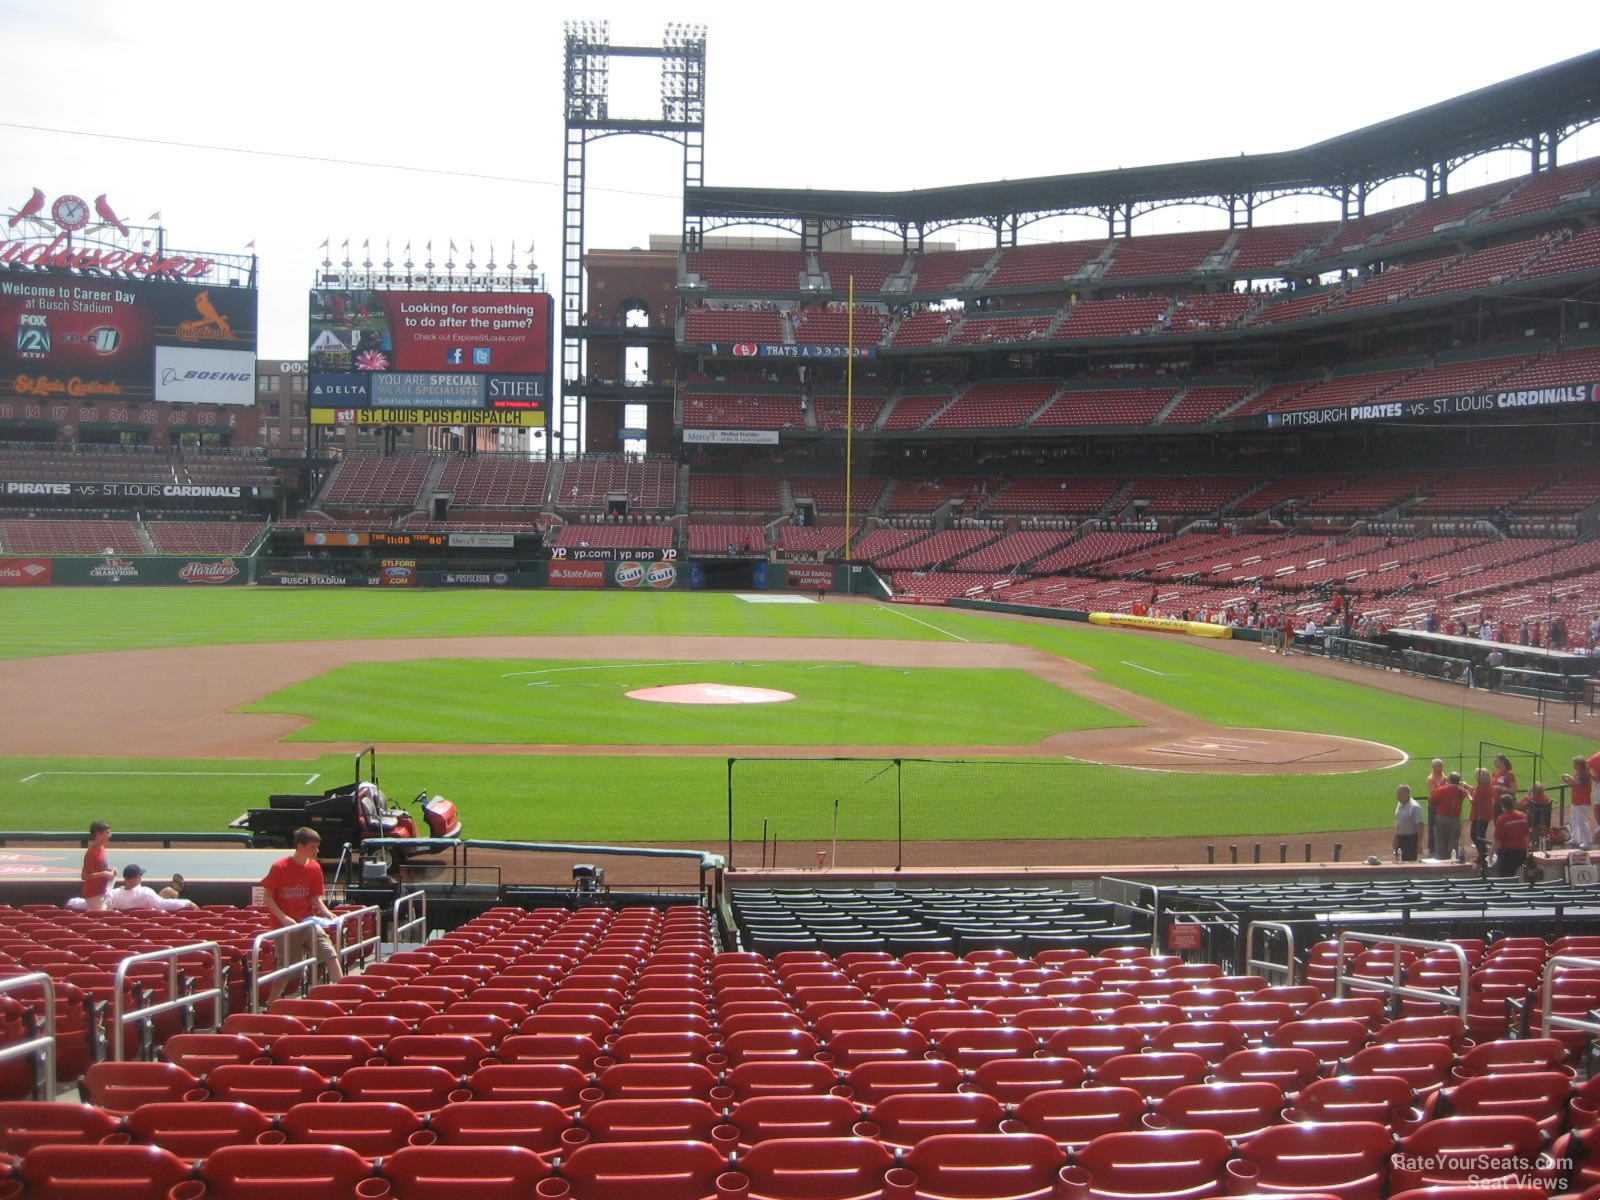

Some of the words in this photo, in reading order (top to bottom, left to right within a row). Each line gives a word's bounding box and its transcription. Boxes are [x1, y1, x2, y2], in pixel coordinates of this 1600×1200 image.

[0, 231, 215, 278] udweiser
[337, 273, 405, 285] WORLD
[411, 272, 524, 286] CHAMPIONS
[2, 282, 55, 297] Welcome
[59, 286, 70, 298] to
[74, 287, 112, 300] Career
[116, 290, 136, 304] Day
[25, 298, 36, 308] at
[39, 298, 70, 311] Busch
[72, 301, 114, 314] Stadium
[400, 302, 448, 315] Looking
[452, 304, 468, 314] for
[471, 304, 534, 316] something
[20, 314, 47, 326] FOX
[405, 317, 417, 326] to
[420, 318, 436, 327] do
[439, 317, 468, 328] after
[470, 318, 490, 328] the
[493, 318, 532, 330] game?
[27, 330, 42, 350] 2
[96, 330, 117, 350] 11
[414, 333, 436, 341] Check
[766, 346, 798, 356] THAT'S
[802, 347, 809, 356] A
[184, 370, 252, 382] BOEING
[378, 374, 401, 385] YOU
[404, 375, 424, 386] ARE
[430, 376, 478, 386] SPECIAL
[327, 385, 366, 394] DELTA
[416, 386, 478, 396] SPECIALISTS
[490, 378, 543, 396] STIFEL
[1282, 408, 1347, 426] PITTSBURGH
[1350, 404, 1402, 420] PIRATES
[1433, 400, 1450, 414] ST.
[1455, 395, 1493, 412] LOUIS
[1498, 386, 1585, 408] CARDINALS
[25, 406, 41, 420] 14
[80, 408, 98, 422] 20
[110, 409, 128, 422] 24
[140, 410, 158, 424] 42
[168, 411, 187, 424] 45
[361, 409, 379, 422] ST.
[382, 409, 418, 422] LOUIS
[423, 410, 522, 424] POST-DISPATCH
[8, 482, 71, 494] PIRATES
[103, 485, 120, 496] ST.
[124, 485, 161, 496] LOUIS
[164, 486, 240, 497] CARDINALS
[387, 536, 410, 544] 11:08
[552, 548, 566, 558] yp
[574, 550, 610, 559] yp.com
[620, 551, 632, 560] yp
[635, 552, 654, 560] app
[662, 549, 677, 559] yp
[456, 575, 490, 583] POSTSEASON
[618, 568, 642, 581] Gulf
[648, 570, 674, 582] Gulf
